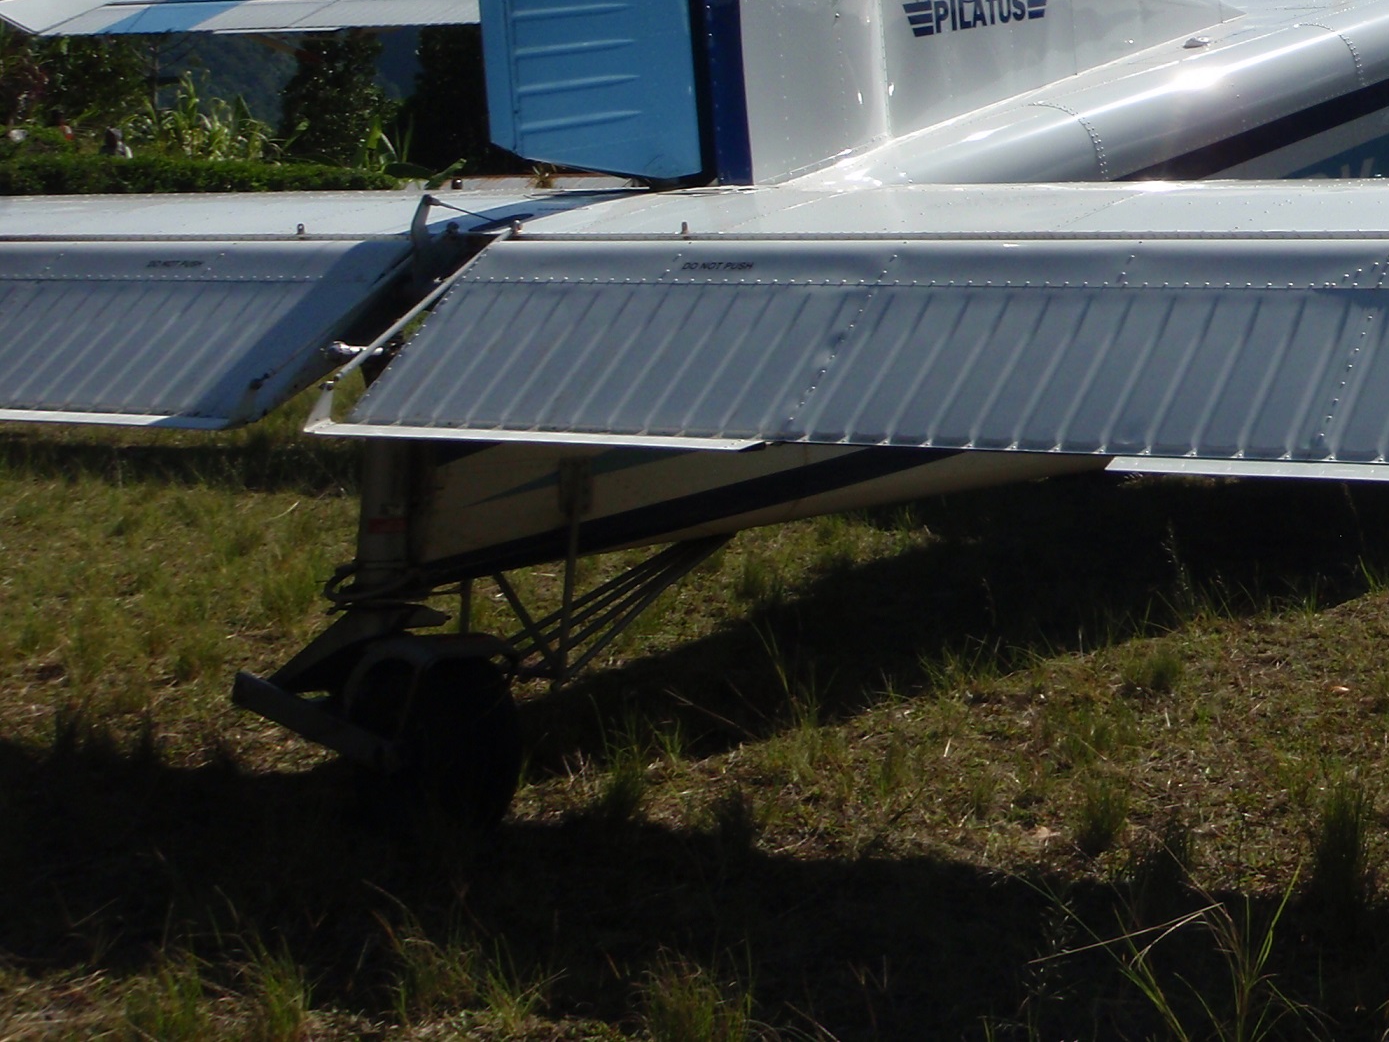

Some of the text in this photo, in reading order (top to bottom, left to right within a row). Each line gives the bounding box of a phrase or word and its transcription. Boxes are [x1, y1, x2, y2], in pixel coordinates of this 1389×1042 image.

[682, 261, 754, 270] DO NOT PUSH
